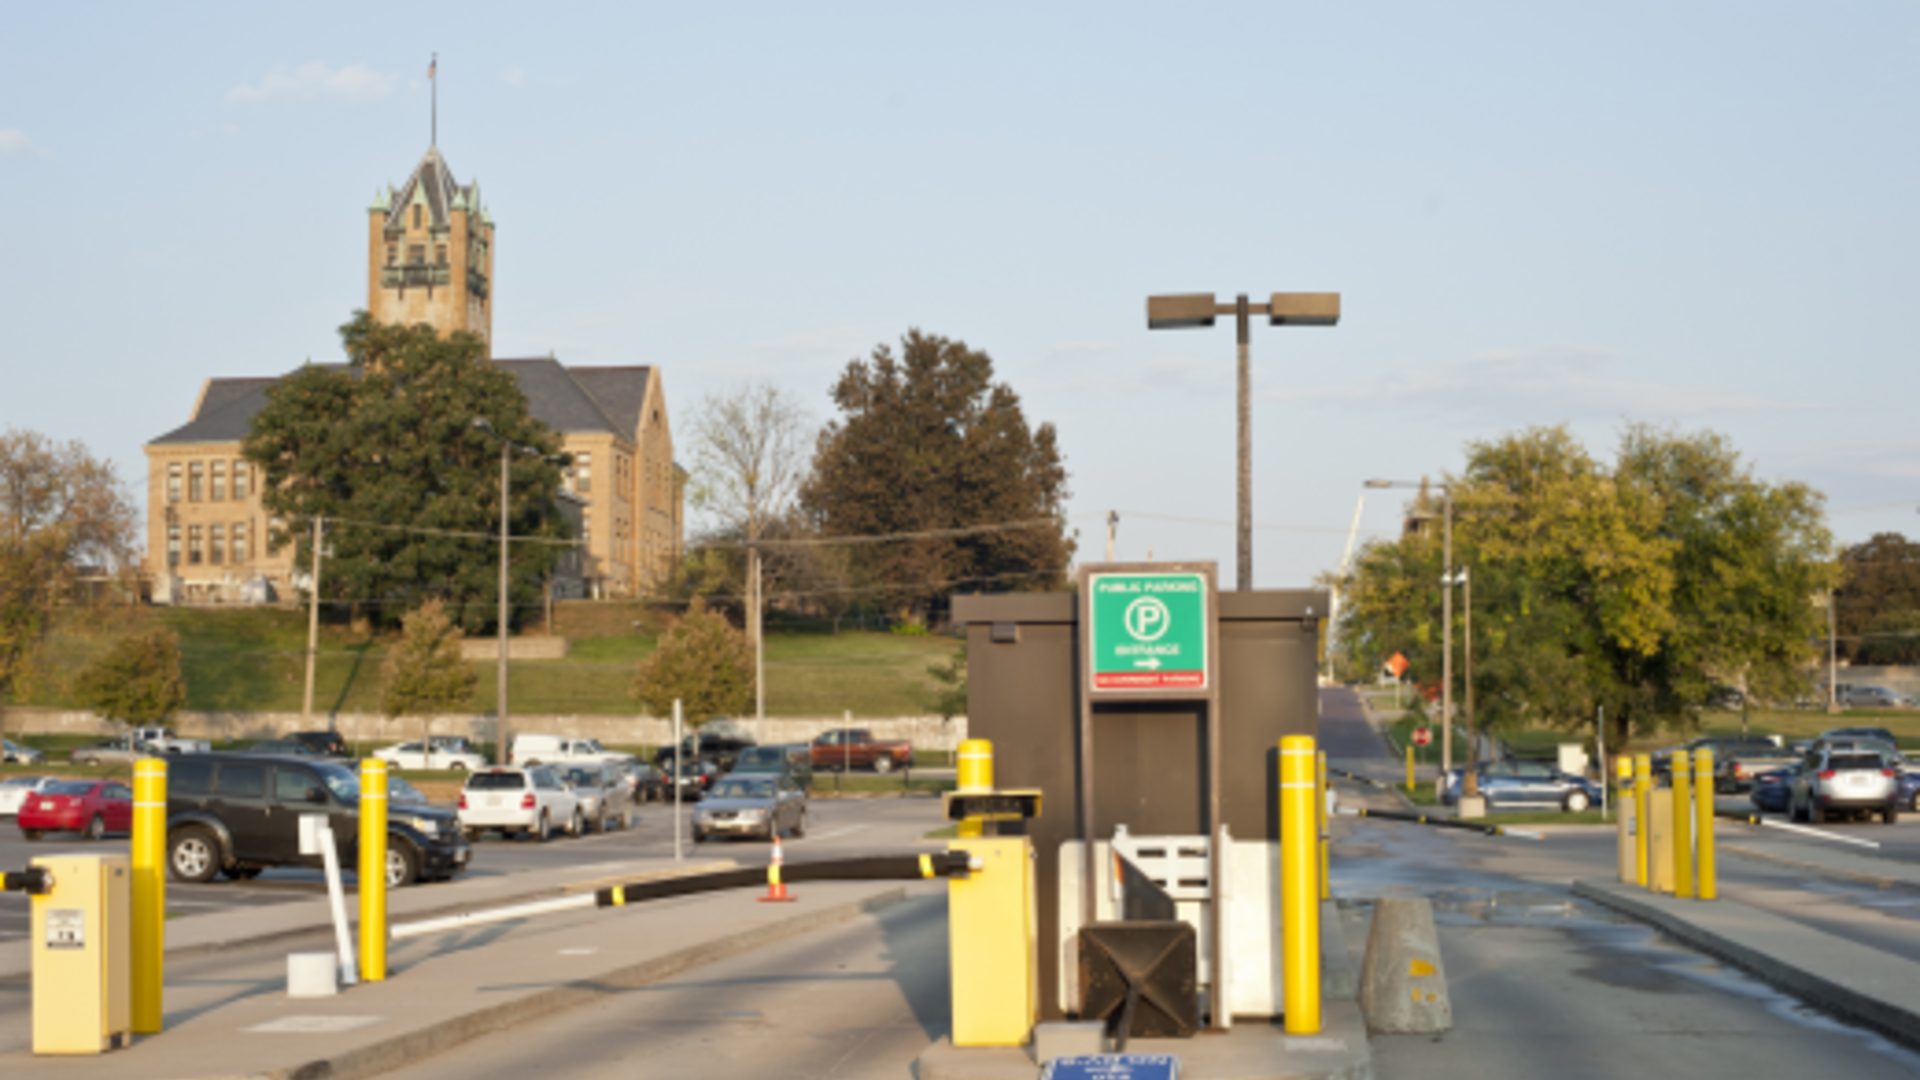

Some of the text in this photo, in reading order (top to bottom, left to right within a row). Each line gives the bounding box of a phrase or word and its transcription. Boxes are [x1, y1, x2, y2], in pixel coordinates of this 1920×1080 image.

[1099, 580, 1198, 593] PUBLIC PARKING
[1137, 606, 1160, 634] P
